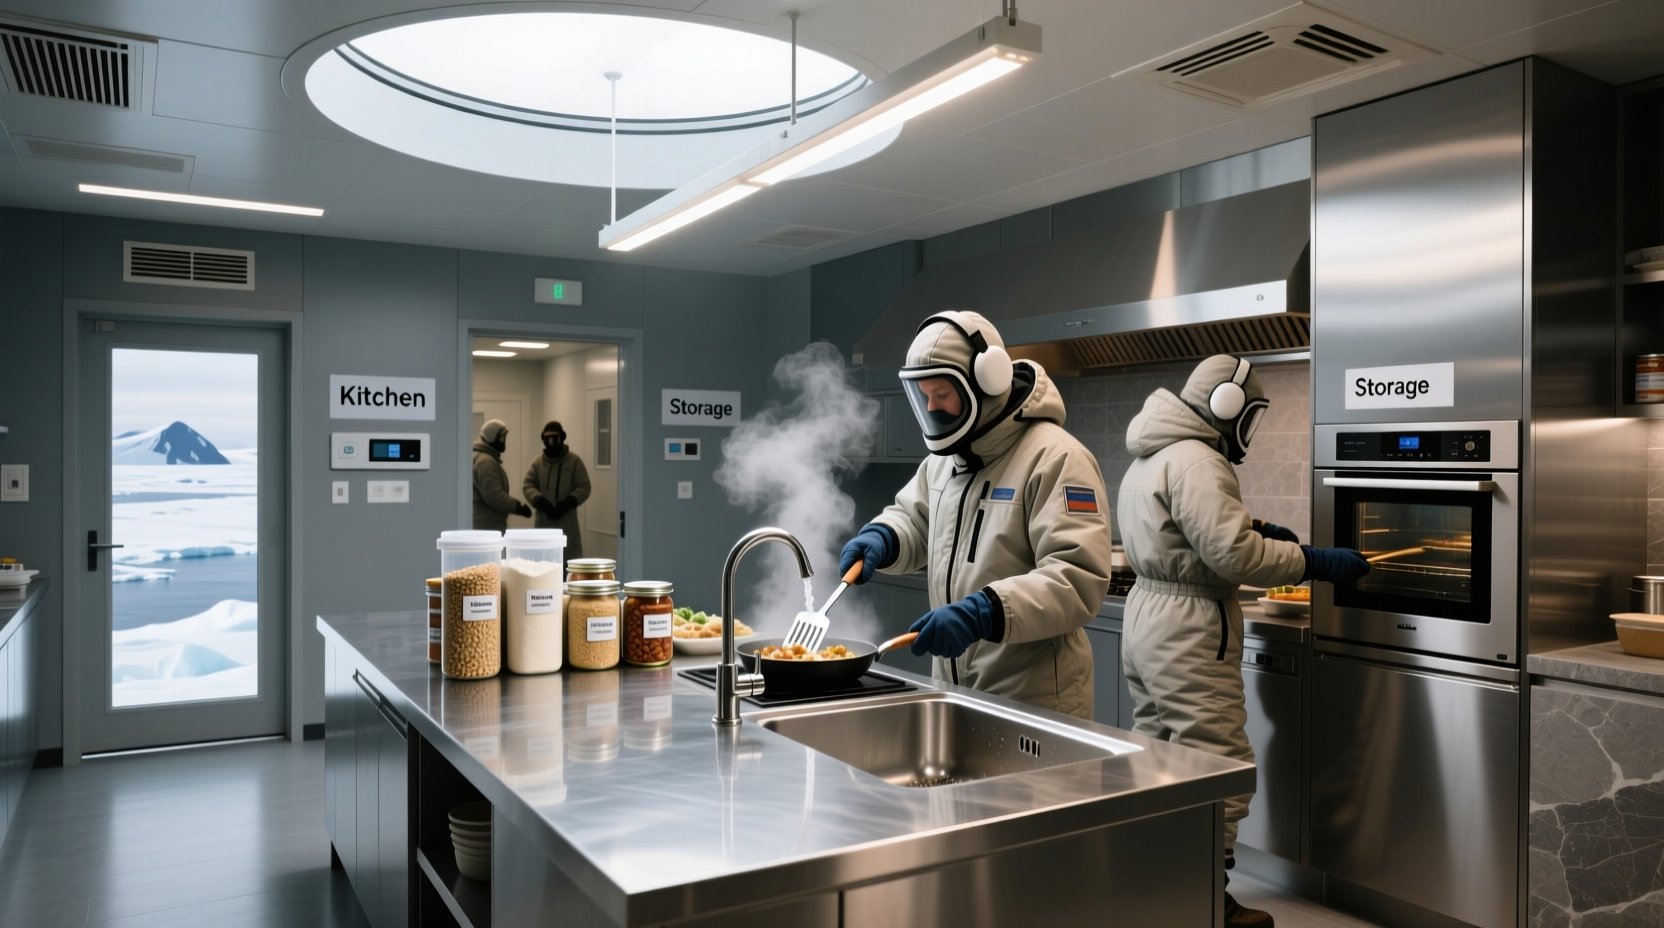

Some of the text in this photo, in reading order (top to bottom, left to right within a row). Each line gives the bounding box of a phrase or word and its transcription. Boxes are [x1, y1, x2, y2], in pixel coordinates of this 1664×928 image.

[340, 385, 426, 408] Kitchen
[1355, 377, 1430, 400] Storage
[670, 398, 733, 420] Storage
